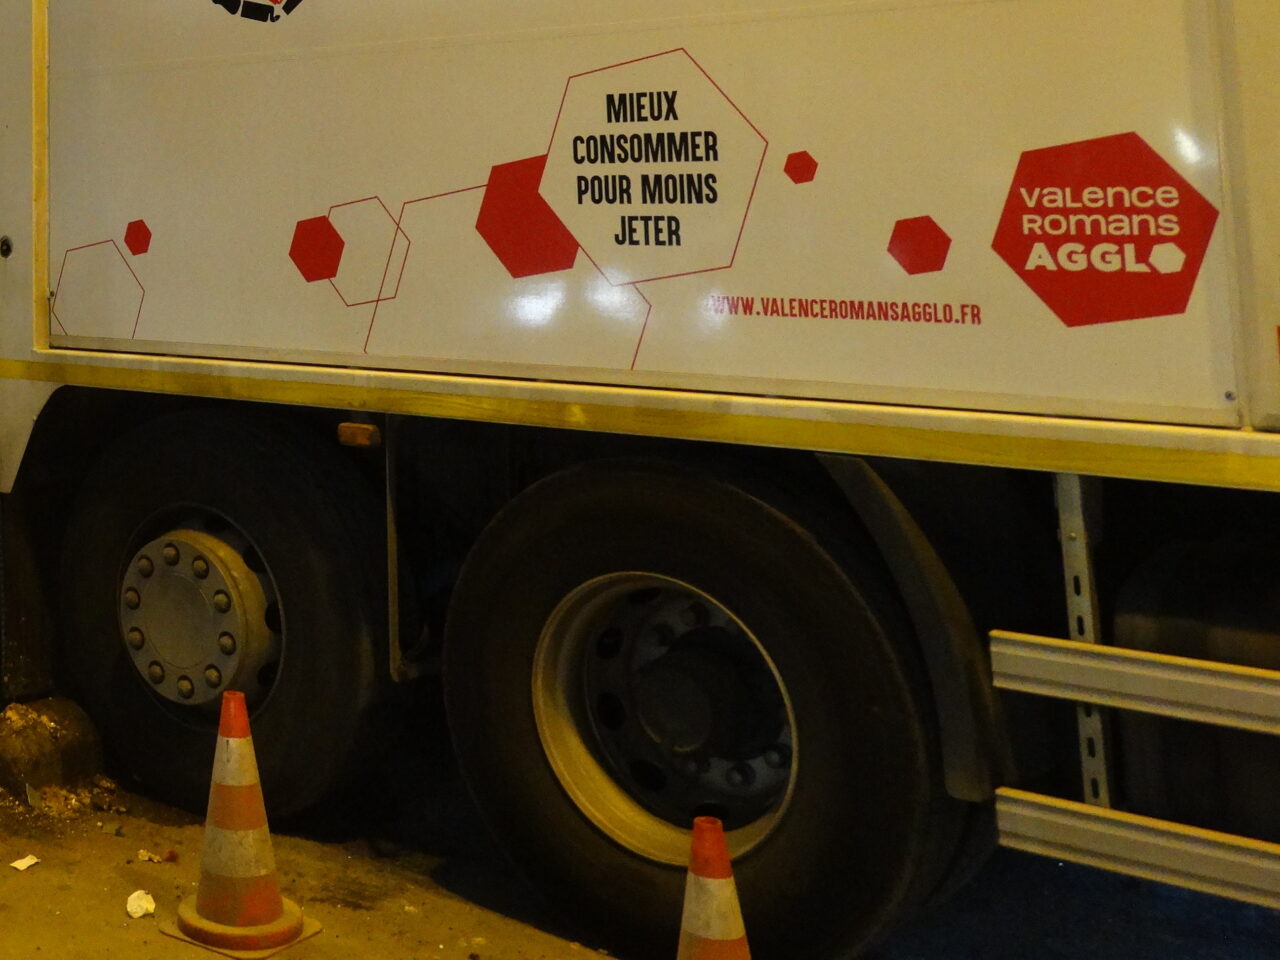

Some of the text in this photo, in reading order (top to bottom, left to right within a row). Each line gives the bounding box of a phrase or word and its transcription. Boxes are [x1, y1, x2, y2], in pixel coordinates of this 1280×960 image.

[606, 90, 678, 123] MIEUX
[572, 131, 718, 164] CONSOMMER
[577, 173, 718, 205] POUR MOINS
[614, 216, 681, 246] JETER
